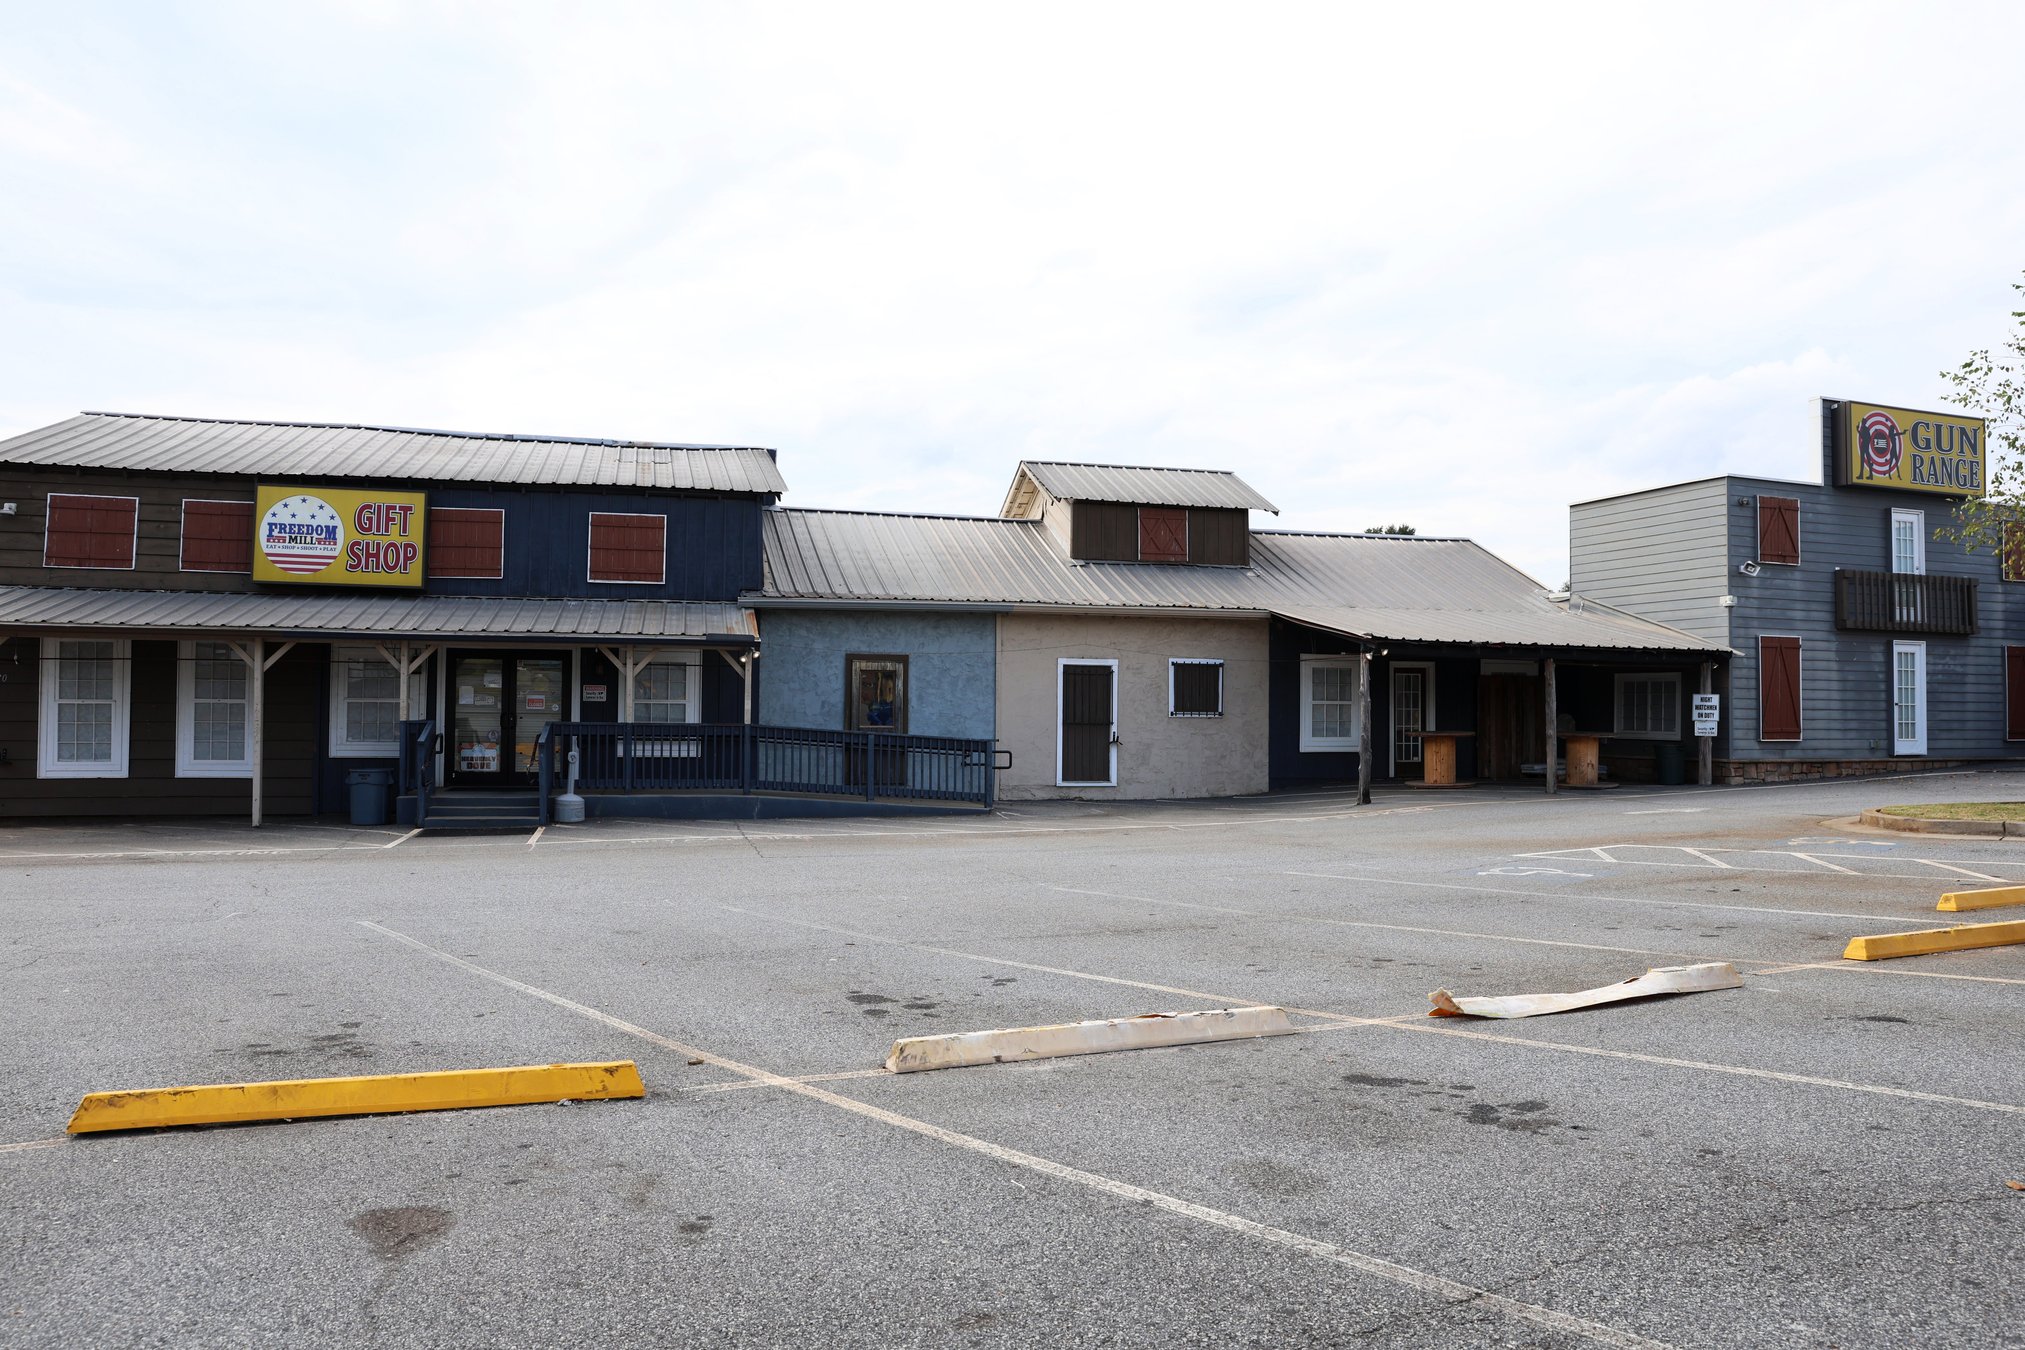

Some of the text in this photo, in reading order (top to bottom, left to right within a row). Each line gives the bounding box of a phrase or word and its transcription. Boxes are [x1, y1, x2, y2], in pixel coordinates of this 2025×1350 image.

[1910, 420, 1979, 457] GUN
[1911, 453, 1981, 490] RANGE
[267, 522, 338, 540] FREEDOM
[355, 502, 414, 536] GIFT
[288, 535, 316, 545] MILL
[346, 540, 418, 574] SHOP
